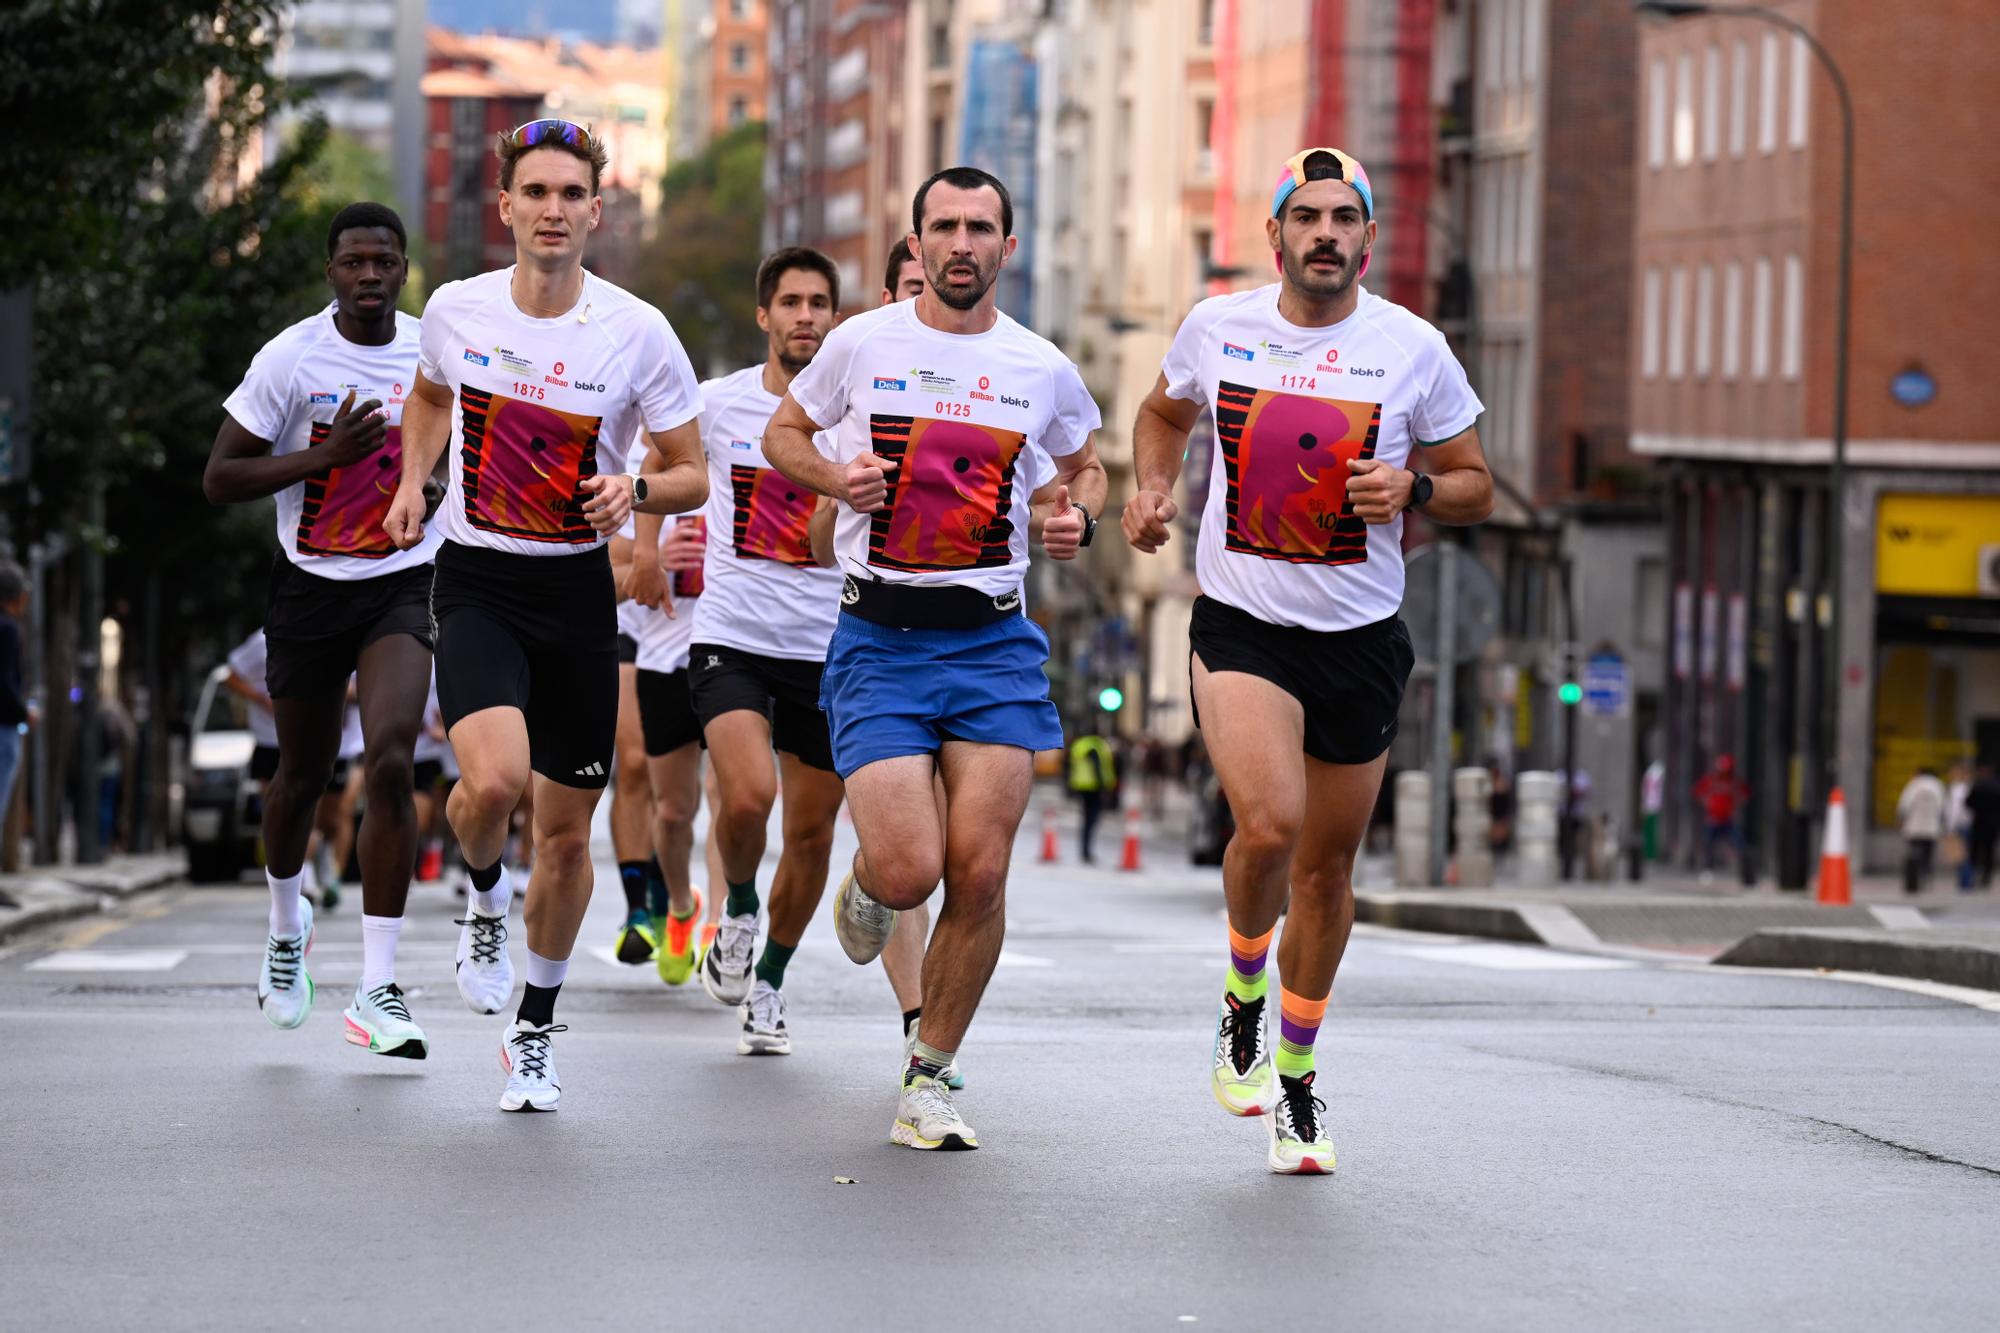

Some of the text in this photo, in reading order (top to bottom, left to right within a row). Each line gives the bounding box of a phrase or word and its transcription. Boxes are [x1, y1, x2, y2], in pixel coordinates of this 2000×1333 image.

[1316, 363, 1342, 374] Bilbao
[1350, 367, 1374, 377] bbk
[544, 375, 568, 388] Bilbao
[574, 381, 596, 392] bbk
[1281, 374, 1316, 390] 1174
[513, 382, 545, 400] 1875
[969, 390, 994, 402] Bilbao
[1000, 395, 1021, 407] bbk
[935, 401, 971, 417] 0125
[1315, 512, 1337, 529] 10
[970, 524, 987, 541] 10
